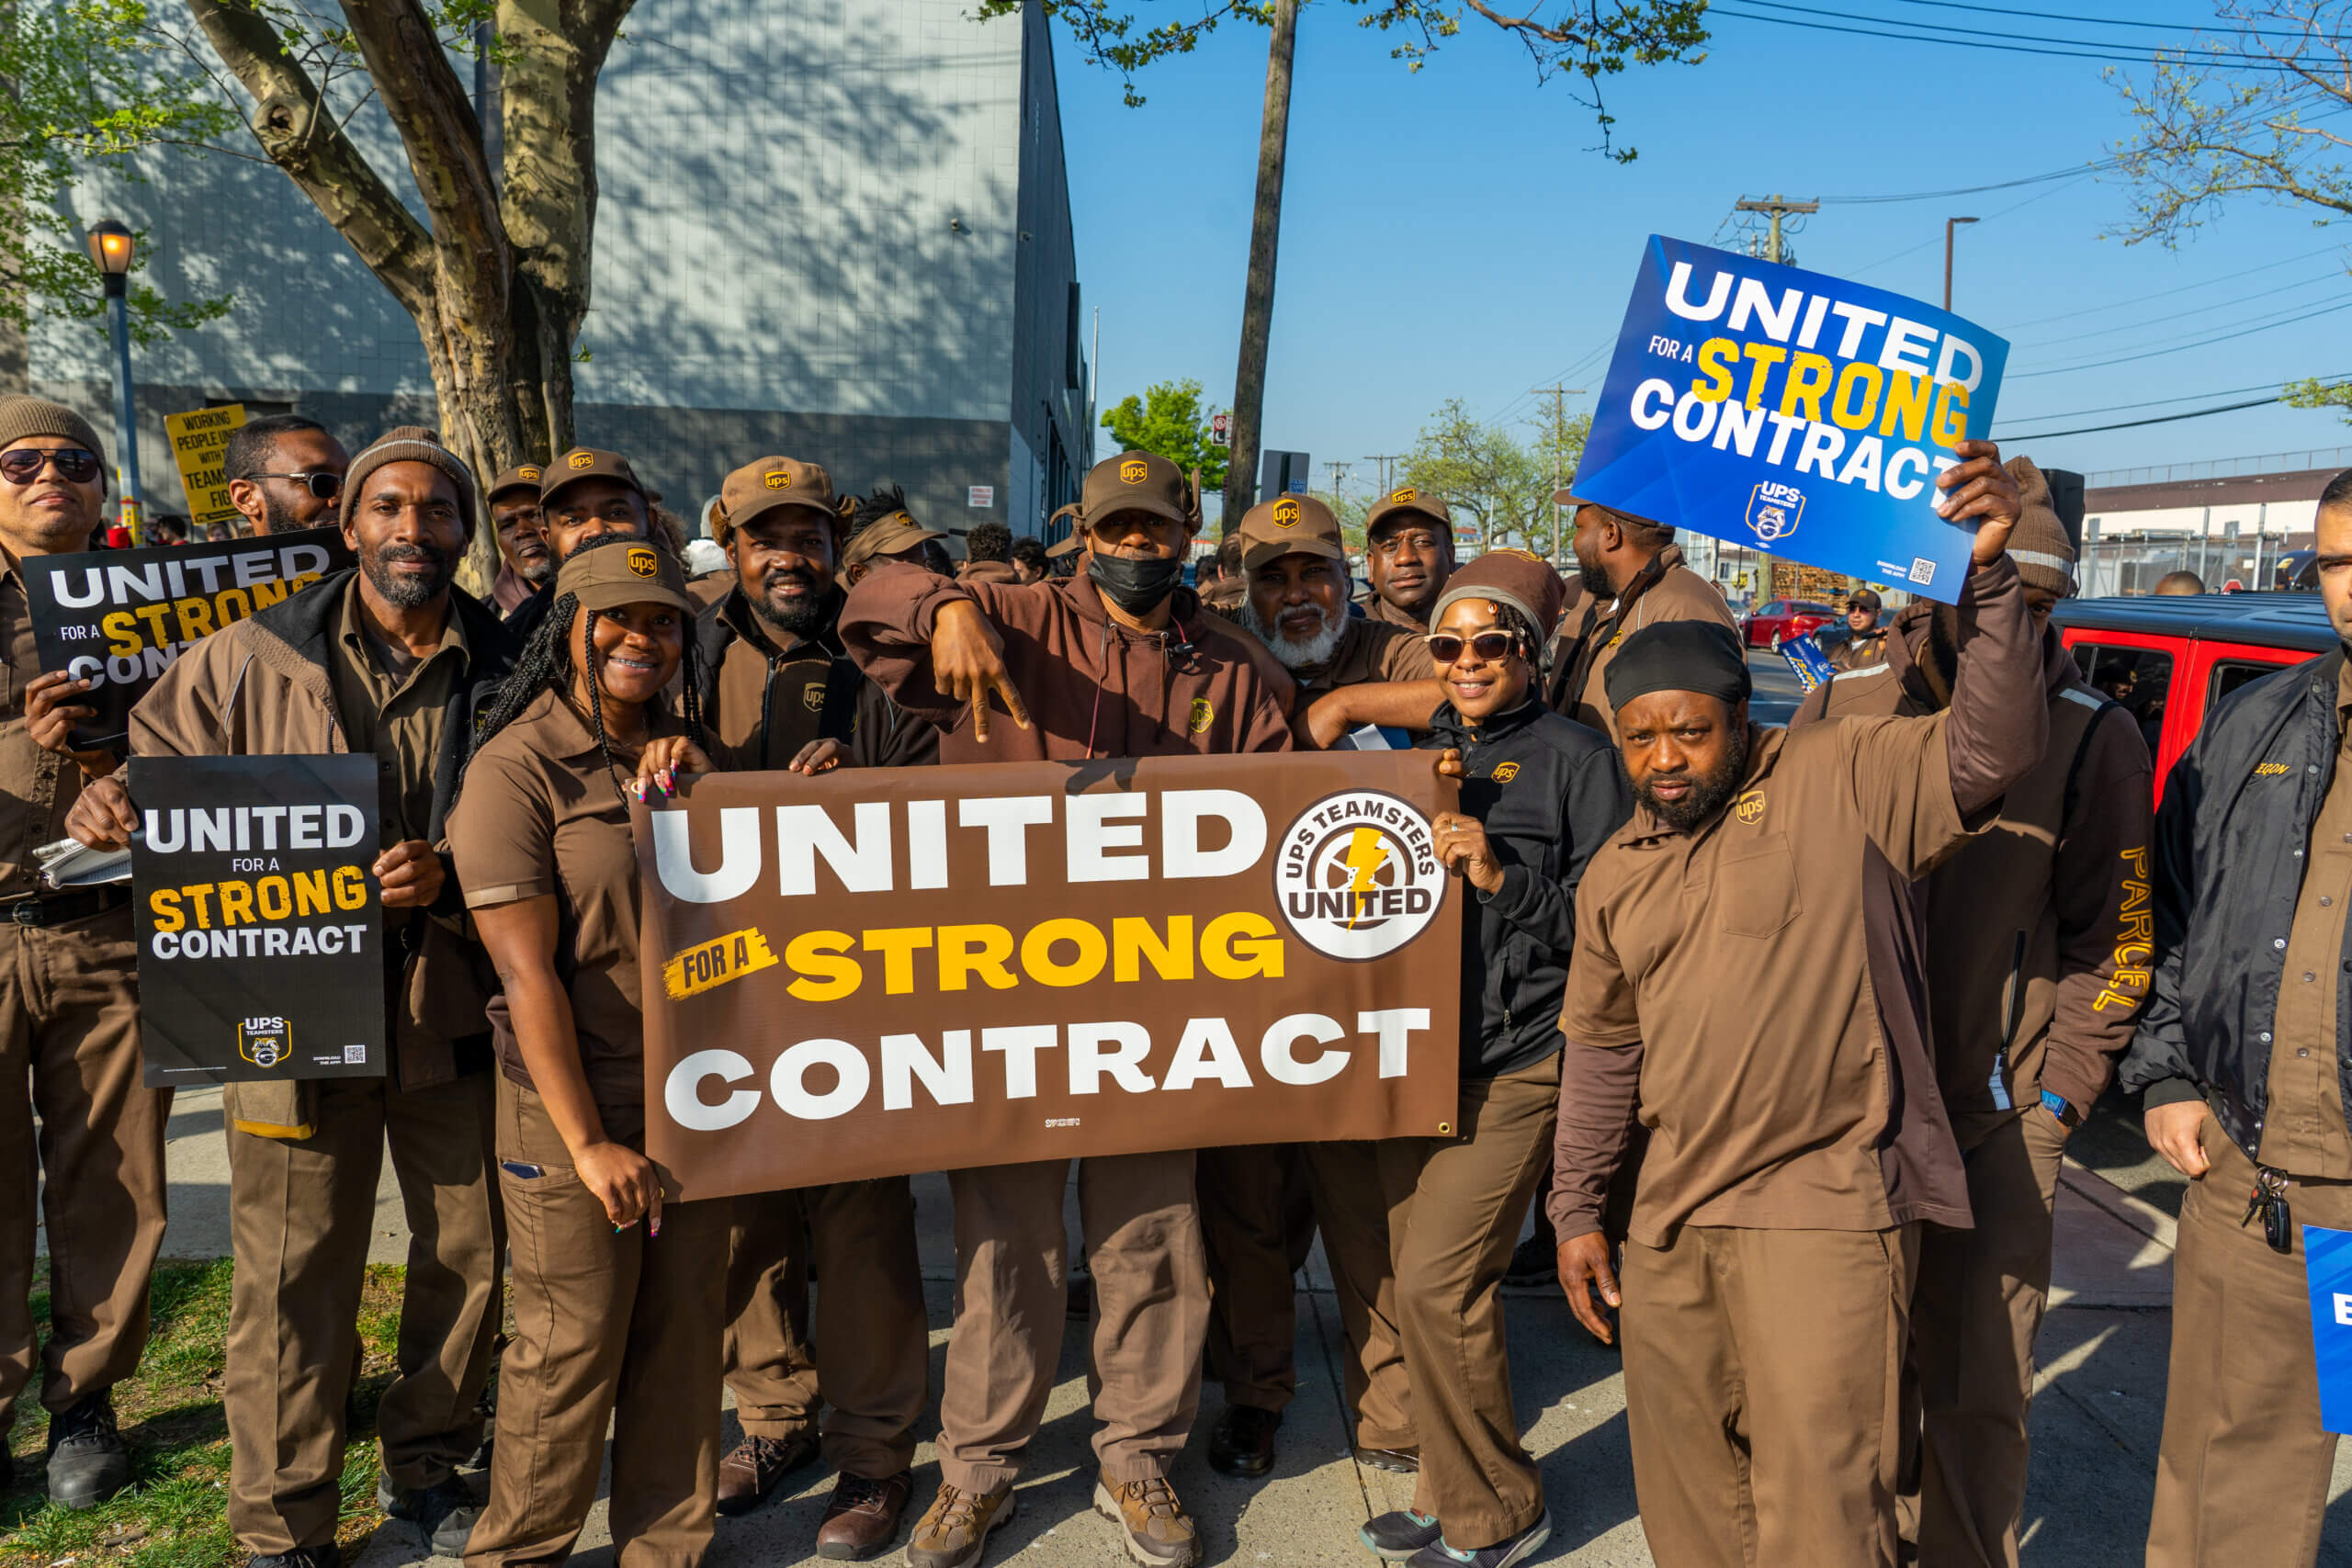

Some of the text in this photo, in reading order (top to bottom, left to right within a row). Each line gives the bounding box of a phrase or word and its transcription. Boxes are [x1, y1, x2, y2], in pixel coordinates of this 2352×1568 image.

[1665, 261, 1984, 394] UNITED
[1648, 334, 1693, 364] FOR A
[1691, 336, 1970, 449] STRONG
[182, 411, 232, 431] WORKING
[176, 431, 218, 451] PEOPLE
[198, 450, 221, 464] WITH
[571, 456, 593, 468] ups
[521, 469, 538, 479] ups
[767, 477, 788, 488] ups
[1122, 467, 1147, 479] ups
[1395, 492, 1413, 502] ups
[1760, 480, 1801, 502] UPS
[1274, 506, 1298, 525] ups
[629, 556, 655, 572] ups
[50, 544, 331, 608] UNITED
[61, 624, 100, 640] FOR A
[1495, 767, 1516, 780] ups
[1739, 799, 1764, 820] ups
[144, 805, 366, 853] UNITED
[1285, 800, 1435, 879] UPS TEAMSTERS
[651, 788, 1268, 904] UNITED
[232, 857, 280, 872] FOR A
[150, 865, 368, 932] STRONG
[1288, 888, 1431, 919] UNITED
[2092, 845, 2154, 1011] PARCEL
[152, 925, 368, 959] CONTRACT
[683, 936, 750, 989] FOR A
[786, 911, 1285, 1003] STRONG
[245, 1016, 284, 1030] UPS
[663, 1007, 1430, 1132] CONTRACT
